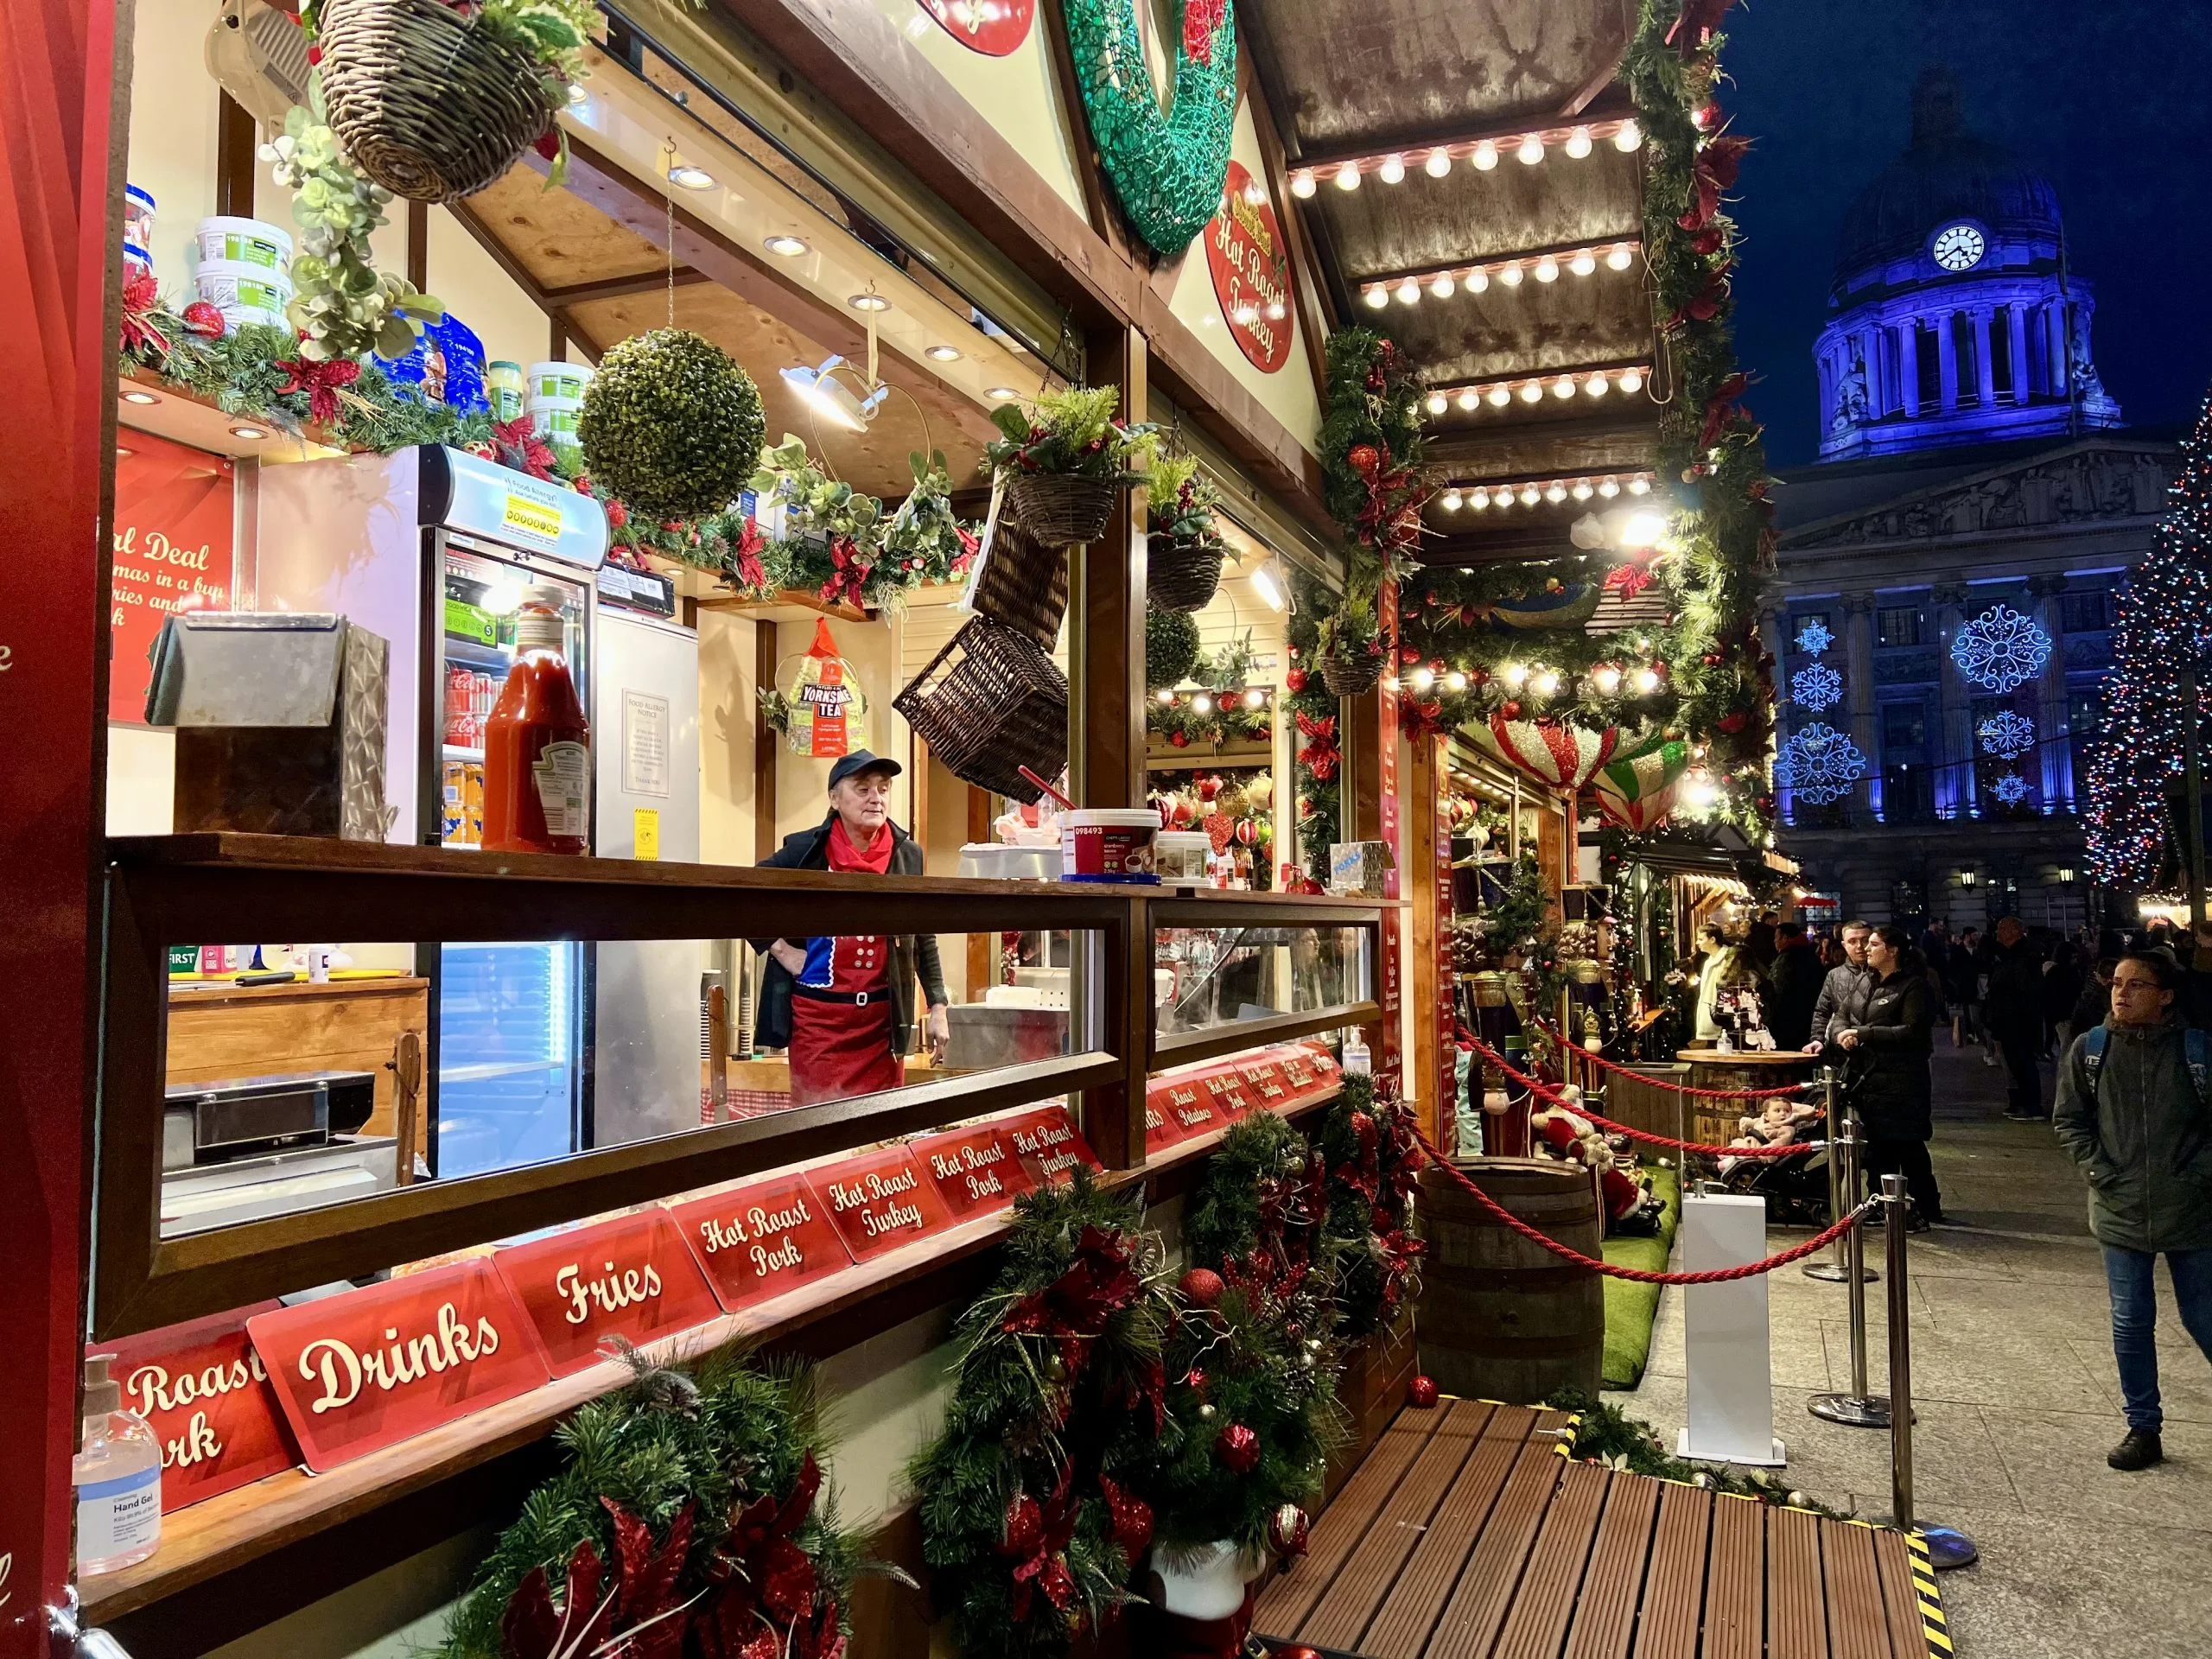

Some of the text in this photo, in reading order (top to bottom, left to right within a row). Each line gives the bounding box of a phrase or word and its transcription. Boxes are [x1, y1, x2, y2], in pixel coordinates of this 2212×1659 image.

[1216, 210, 1243, 273] Hot
[1248, 248, 1285, 308] Roast
[143, 532, 209, 570] Deal
[113, 564, 149, 582] mas
[156, 570, 173, 588] in
[177, 579, 189, 591] a
[112, 586, 183, 613] ries and
[485, 626, 492, 635] 5
[628, 698, 644, 708] FOOD
[637, 709, 658, 719] NOTICE
[820, 704, 842, 716] TEA
[1075, 827, 1103, 836] 098493
[1169, 1088, 1197, 1106] Roast
[1205, 1073, 1243, 1095] Hot Roast
[1226, 1091, 1246, 1109] Pork
[1178, 1108, 1211, 1126] Potatoes
[1013, 1122, 1074, 1154] Hot Roast
[931, 1141, 1005, 1179] Hot Roast
[1038, 1151, 1080, 1179] Turkey
[829, 1167, 918, 1211] Hot Roast
[966, 1170, 1002, 1200] Pork
[700, 1198, 811, 1253] Hot Roast
[861, 1200, 924, 1237] Turkey
[749, 1235, 804, 1277] Pork
[556, 1260, 662, 1324] Fries
[298, 1302, 499, 1414] Drinks
[127, 1344, 267, 1419] Roast
[160, 1410, 222, 1470] rk
[113, 1498, 139, 1513] Hand
[141, 1493, 153, 1504] Gel
